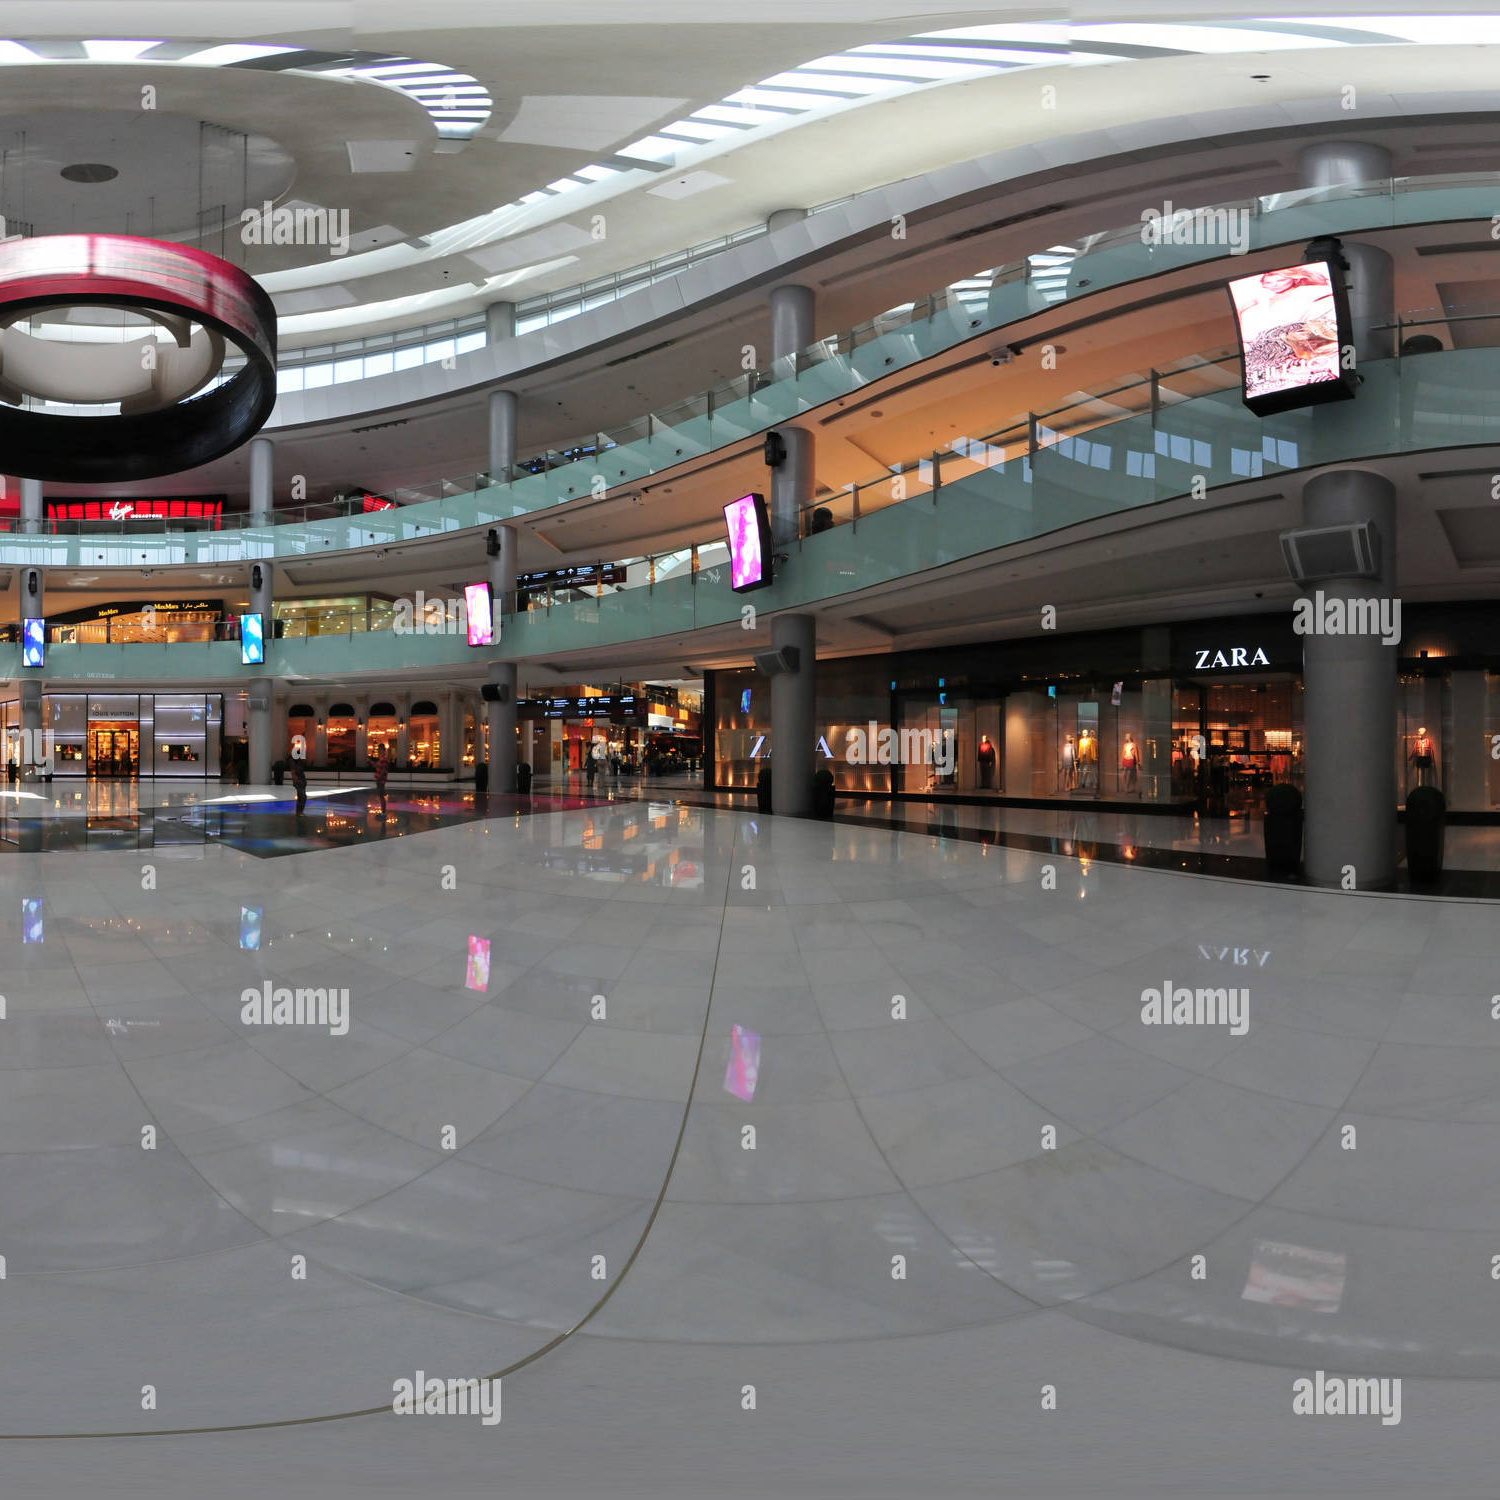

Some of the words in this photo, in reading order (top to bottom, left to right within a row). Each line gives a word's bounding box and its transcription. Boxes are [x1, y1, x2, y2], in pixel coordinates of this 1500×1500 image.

[109, 501, 135, 520] Virgin
[1195, 647, 1271, 669] ZARA
[749, 735, 835, 759] ZA
